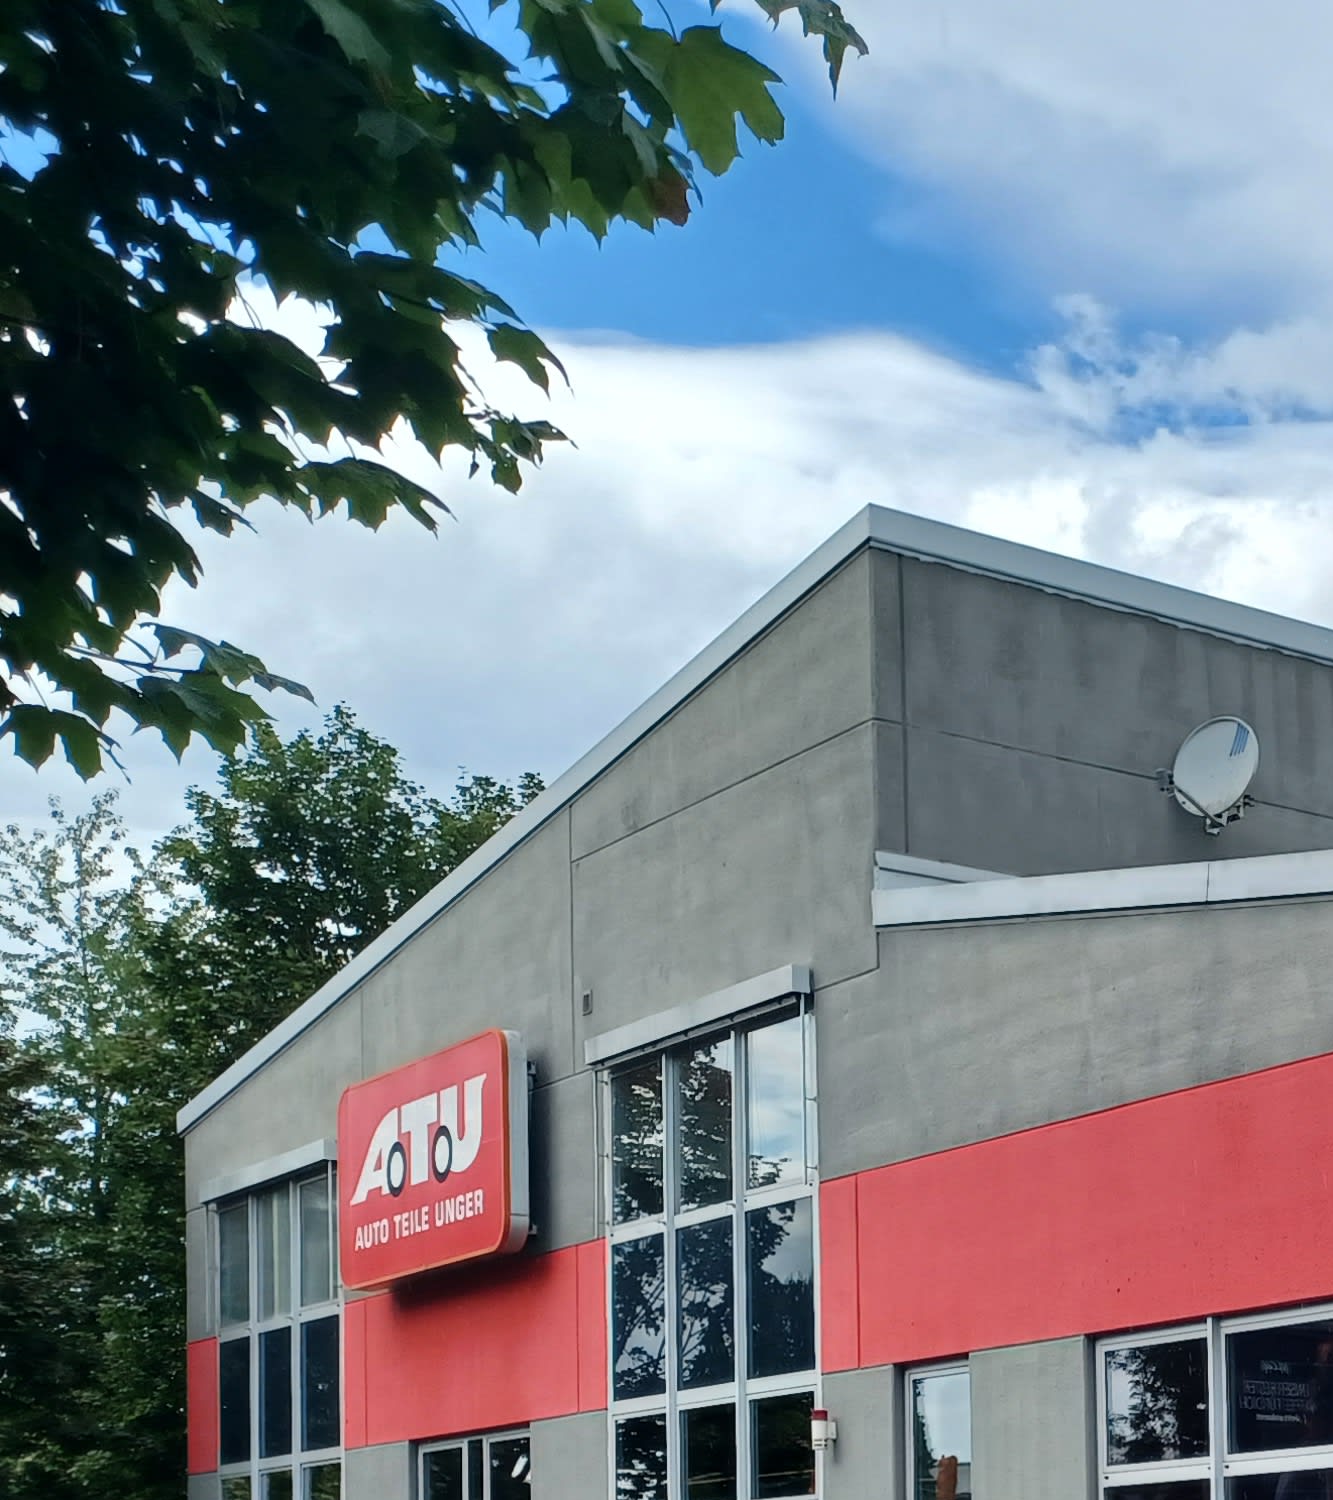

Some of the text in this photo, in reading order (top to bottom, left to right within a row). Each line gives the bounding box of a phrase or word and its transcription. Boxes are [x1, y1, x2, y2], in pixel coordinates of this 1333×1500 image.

[350, 1073, 487, 1206] ATU
[354, 1188, 484, 1251] AUTO TEILE UNGER
